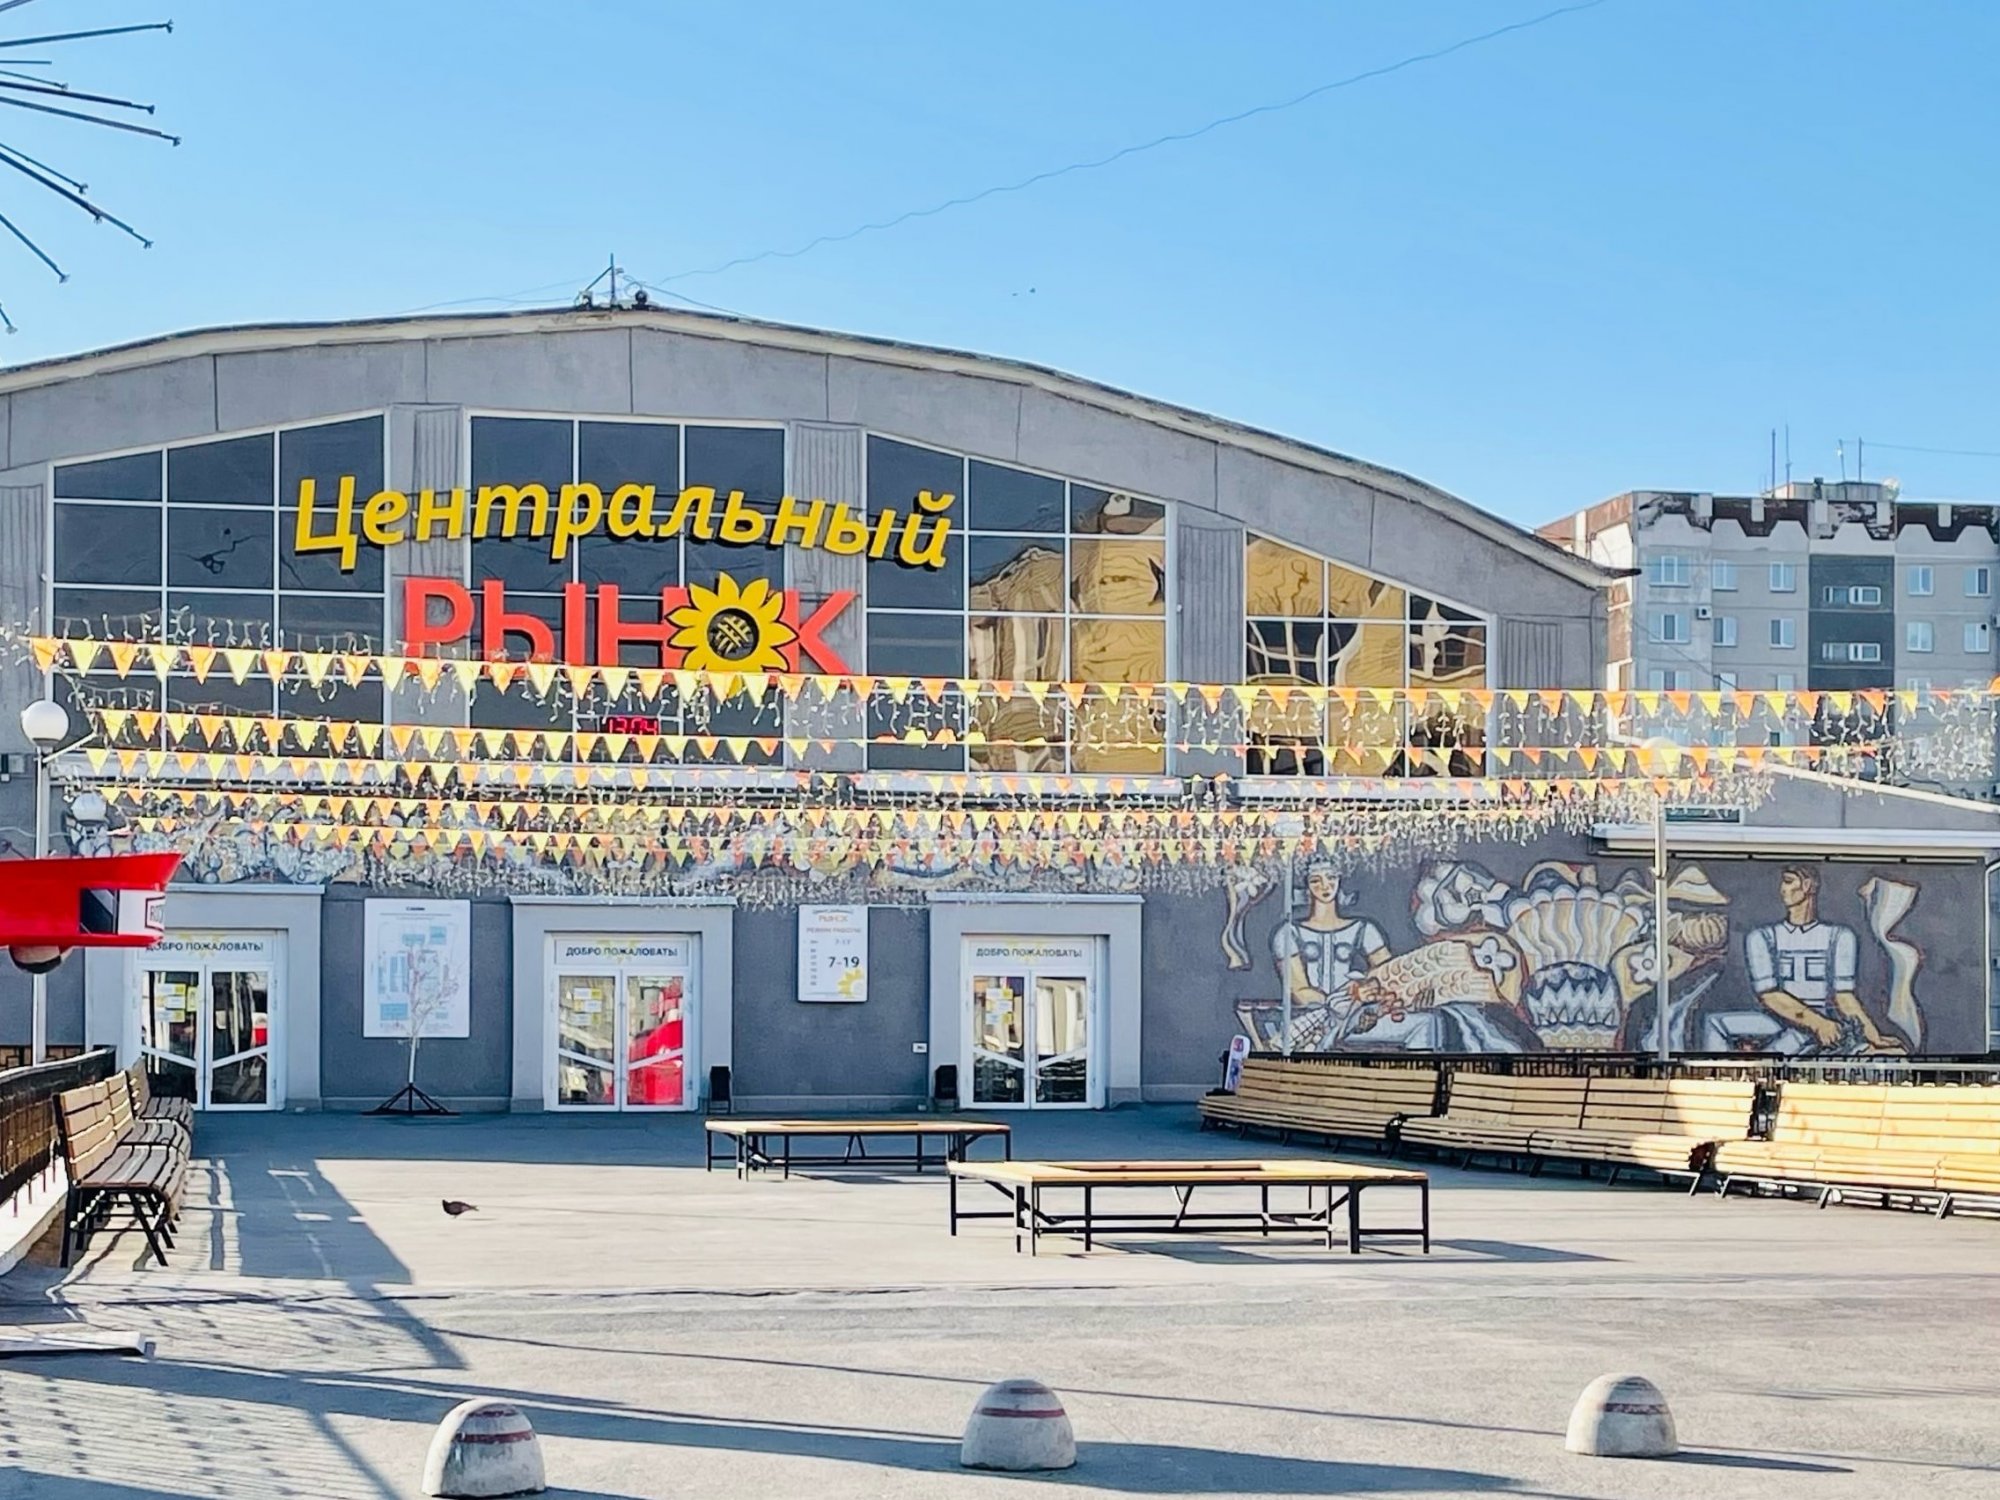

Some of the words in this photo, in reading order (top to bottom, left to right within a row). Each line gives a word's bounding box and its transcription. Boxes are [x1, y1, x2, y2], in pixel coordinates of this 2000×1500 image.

[294, 475, 955, 571] Центральный
[566, 947, 601, 956] ДОБРО
[976, 948, 1010, 957] ДОБРО
[828, 956, 860, 968] 7-19
